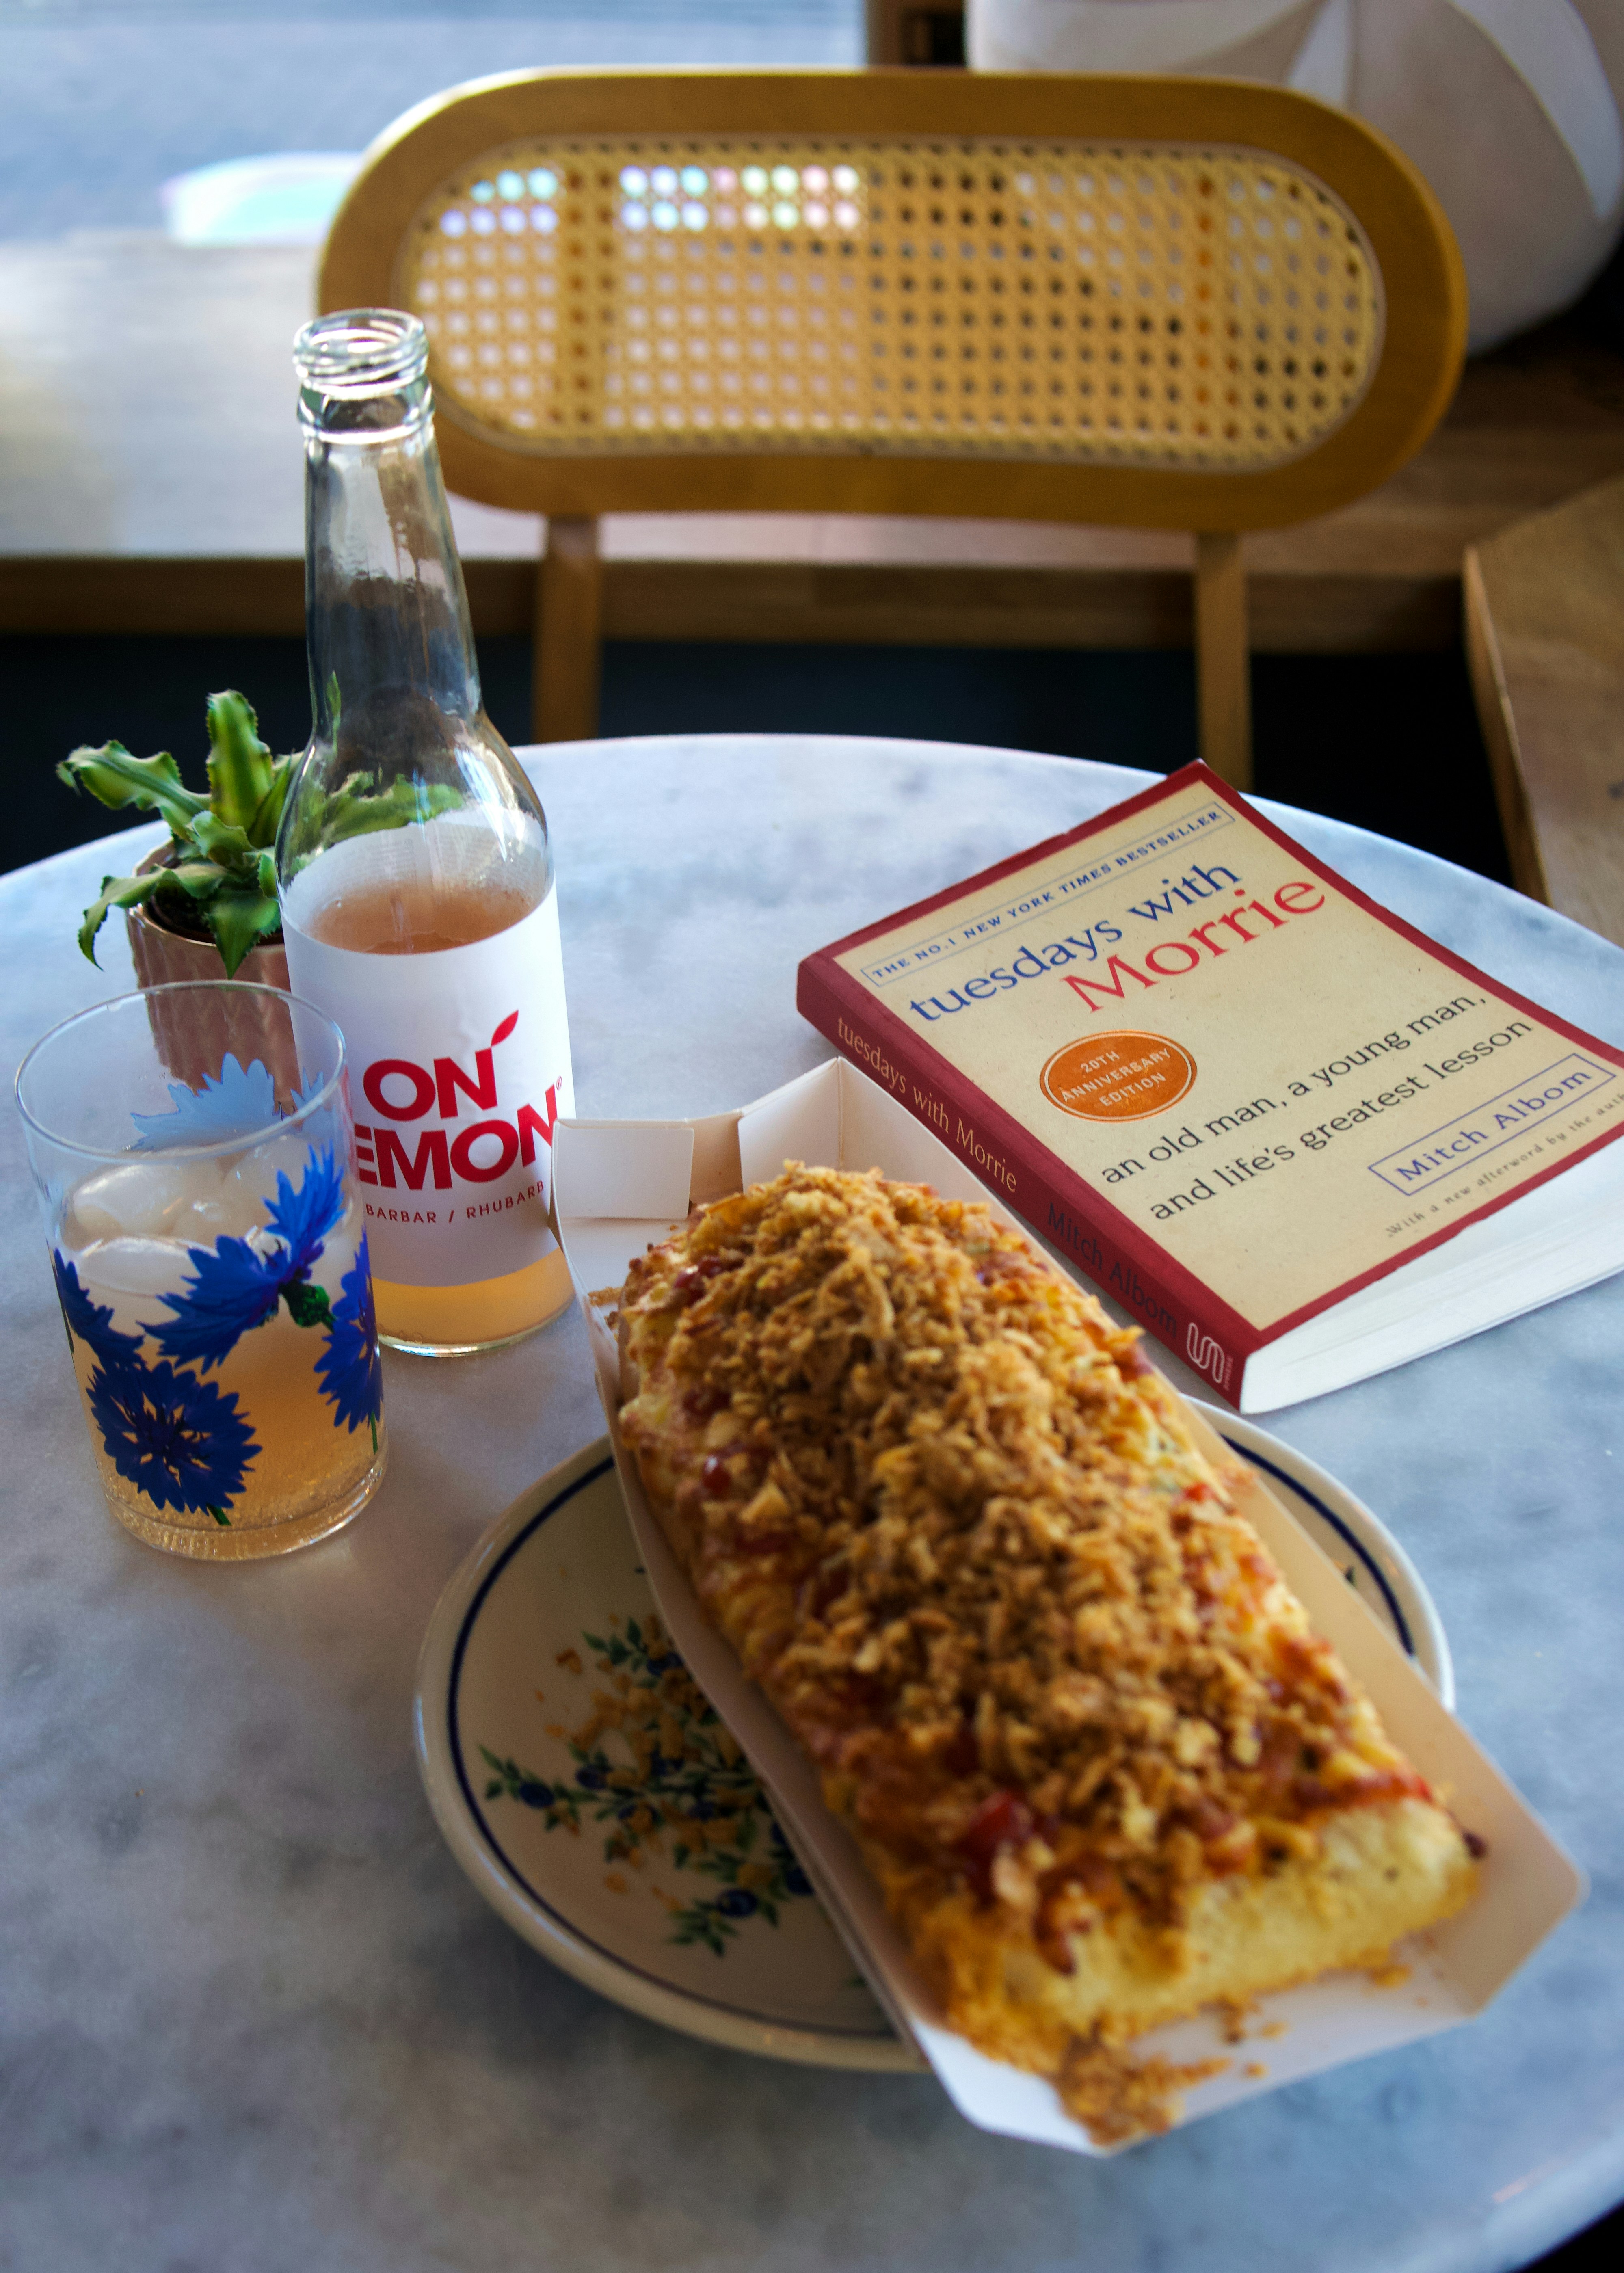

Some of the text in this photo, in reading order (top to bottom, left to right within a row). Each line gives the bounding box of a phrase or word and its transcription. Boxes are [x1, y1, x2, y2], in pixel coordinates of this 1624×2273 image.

[871, 811, 1223, 980] THE NO.1 NEW YORK TIMES BESTSELLER
[909, 863, 1243, 1021] tuesdays with
[1059, 880, 1326, 1013] Morrie
[838, 1016, 1017, 1193] tuesdays with Morrie
[1060, 1047, 1171, 1103] ANNIVERSARY
[1080, 1050, 1120, 1074] 20TH
[1099, 1071, 1166, 1107] EDITION
[1101, 996, 1487, 1184] an old man, a young man,
[1150, 1177, 1218, 1220] and
[1300, 1075, 1430, 1151] greatest
[1422, 1021, 1534, 1080] lesson
[1395, 1070, 1594, 1181] Mitch Albom
[352, 1083, 558, 1192] EMON
[466, 1180, 544, 1220] RHUBARB
[1385, 1211, 1426, 1237] With
[1429, 1204, 1440, 1213] a
[1443, 1185, 1471, 1205] new
[1476, 1143, 1544, 1187] afterword
[1545, 1132, 1568, 1145] by
[1568, 1115, 1592, 1132] the
[1047, 1201, 1177, 1339] Mitch Albom
